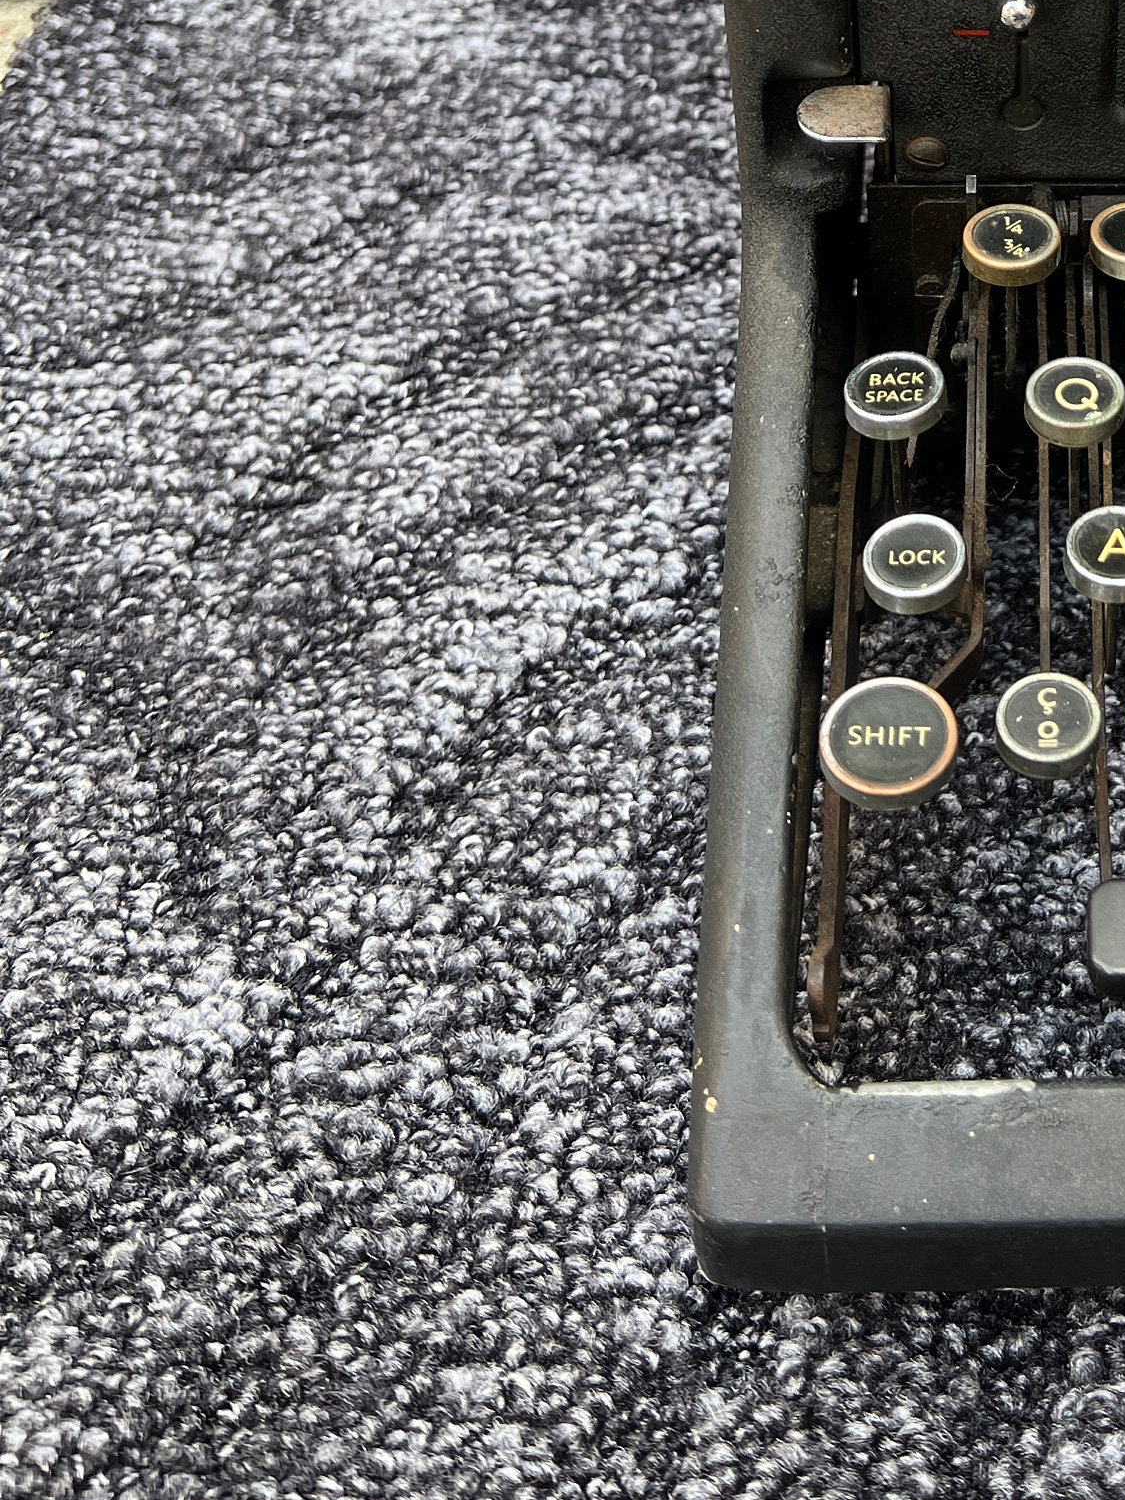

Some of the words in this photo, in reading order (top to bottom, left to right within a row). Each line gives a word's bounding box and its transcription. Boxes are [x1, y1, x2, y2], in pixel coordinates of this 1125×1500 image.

[869, 371, 925, 387] BACK
[864, 388, 925, 405] SPACE
[1054, 377, 1099, 410] Q
[888, 549, 946, 566] LOCK
[847, 724, 932, 747] SHIFT
